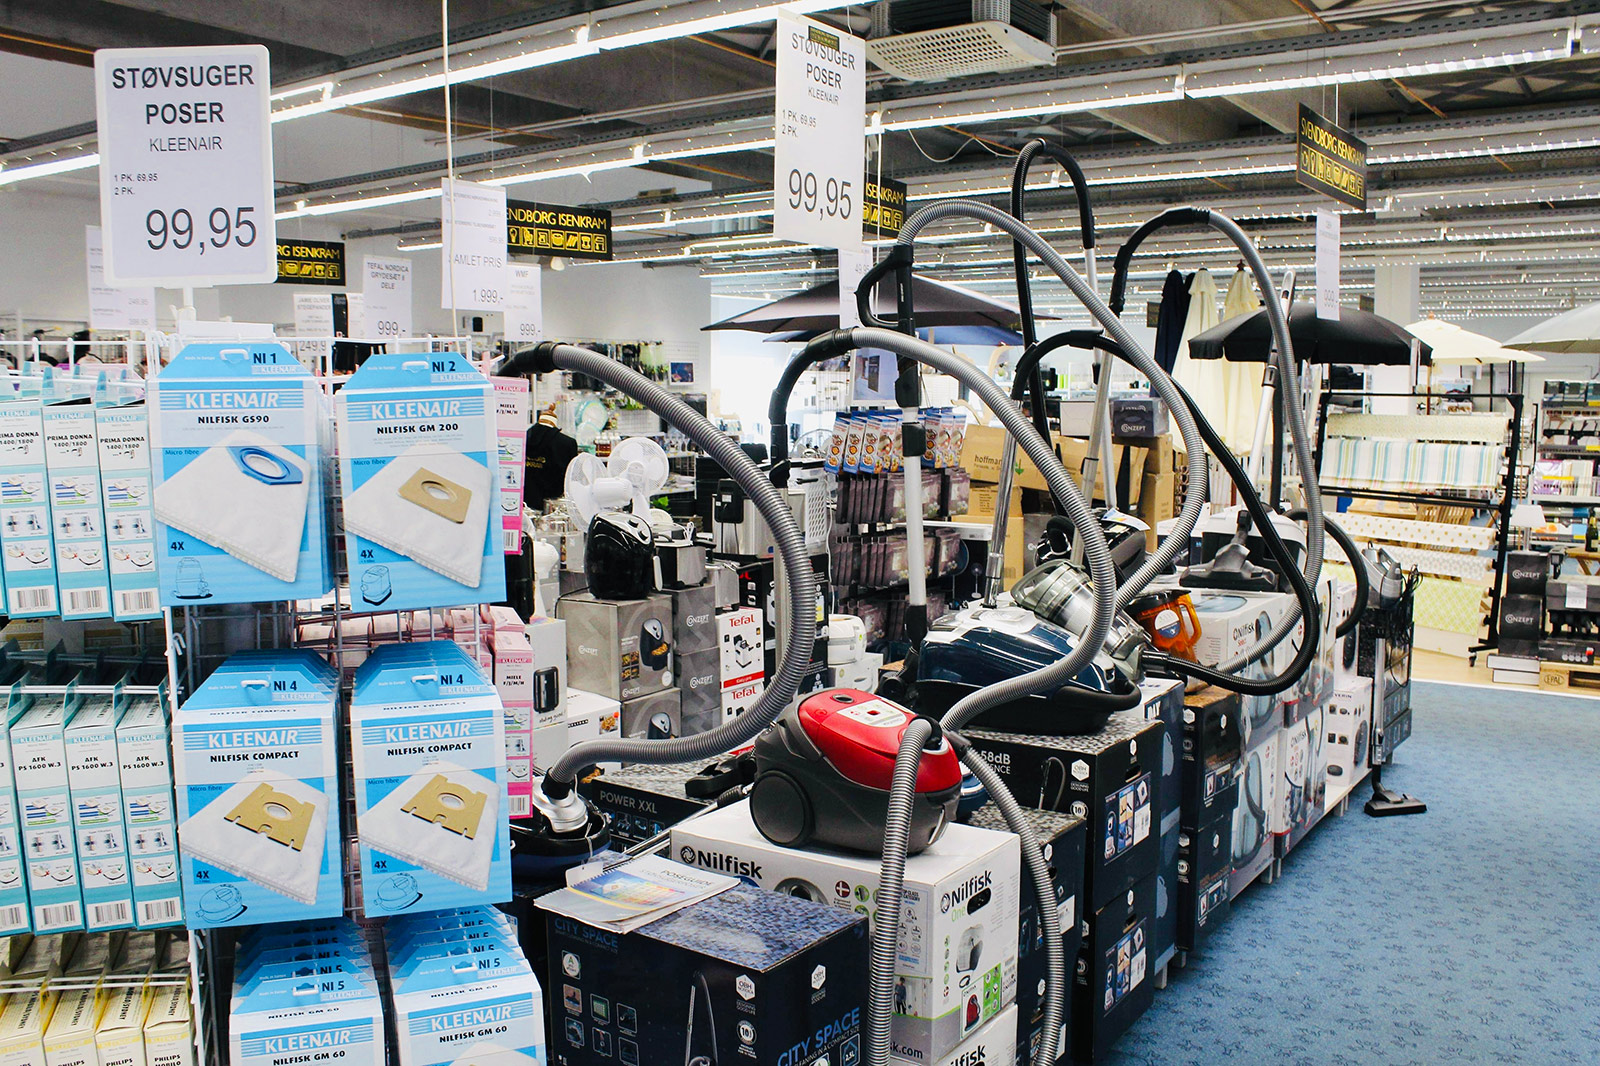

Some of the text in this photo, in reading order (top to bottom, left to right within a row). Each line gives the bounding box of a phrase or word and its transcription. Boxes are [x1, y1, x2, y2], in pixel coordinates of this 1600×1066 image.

[792, 33, 855, 70] STØVSUGER
[112, 64, 254, 89] STØVSUGER
[807, 62, 842, 90] POSER
[808, 87, 839, 105] KLEENAIR
[146, 102, 224, 124] POSER
[800, 114, 817, 128] 69.95
[788, 125, 798, 137] PK.
[150, 136, 222, 152] KLEENAIR
[114, 174, 118, 182] 1
[121, 173, 135, 182] PK.
[114, 187, 135, 195] 2 PK.
[789, 168, 851, 221] 99,95
[558, 214, 606, 231] ISENKRAM
[146, 206, 257, 255] 99,95
[292, 245, 340, 260] ISENKRAM
[367, 262, 384, 271] TEFAL
[448, 254, 482, 268] AMLET
[381, 282, 395, 290] DELE
[253, 353, 277, 364] NI 1
[432, 361, 456, 372] NI 2
[186, 392, 279, 409] KLEENAIR
[0, 409, 31, 417] LEENAIR
[52, 411, 85, 419] KLEENAIR
[372, 401, 460, 420] KLEENAIR
[104, 414, 137, 423] KLEENAIR
[198, 415, 270, 424] NILFISK GS90
[377, 423, 459, 434] NILFISK GM 200
[170, 541, 185, 550] 4X
[360, 549, 374, 559] 4X
[729, 614, 756, 628] Tefal
[273, 681, 298, 691] NI 4
[441, 674, 464, 685] NI 4
[281, 692, 316, 700] KLEENAIR
[732, 686, 757, 700] Tefal
[19, 735, 54, 744] KLEENAIR
[73, 735, 107, 744] KLEENAIR
[125, 734, 158, 743] KLEENAIR
[208, 730, 298, 749] KLEENAIR
[385, 723, 471, 742] KLEENAIR
[387, 742, 472, 756] NILFISK COMPACT
[210, 751, 299, 763] NILFISK COMPACT
[600, 790, 657, 814] POWER XXL
[374, 860, 387, 870] 4X
[698, 850, 762, 880] Nilfisk
[196, 871, 209, 880] 4X
[951, 870, 992, 907] Nilfisk
[951, 906, 966, 922] One
[555, 918, 580, 934] CITY
[583, 928, 618, 948] SPACE
[479, 958, 501, 969] NI 5
[322, 981, 345, 992] NI 5
[431, 1006, 512, 1031] KLEENAIR
[439, 1025, 508, 1043] NILFISK GM 60
[778, 1036, 811, 1066] CITY
[815, 1007, 860, 1049] SPACE
[265, 1030, 351, 1054] KLEENAIR
[155, 1054, 181, 1062] PHILIPS
[273, 1055, 312, 1066] NILFISK
[314, 1052, 330, 1061] GM
